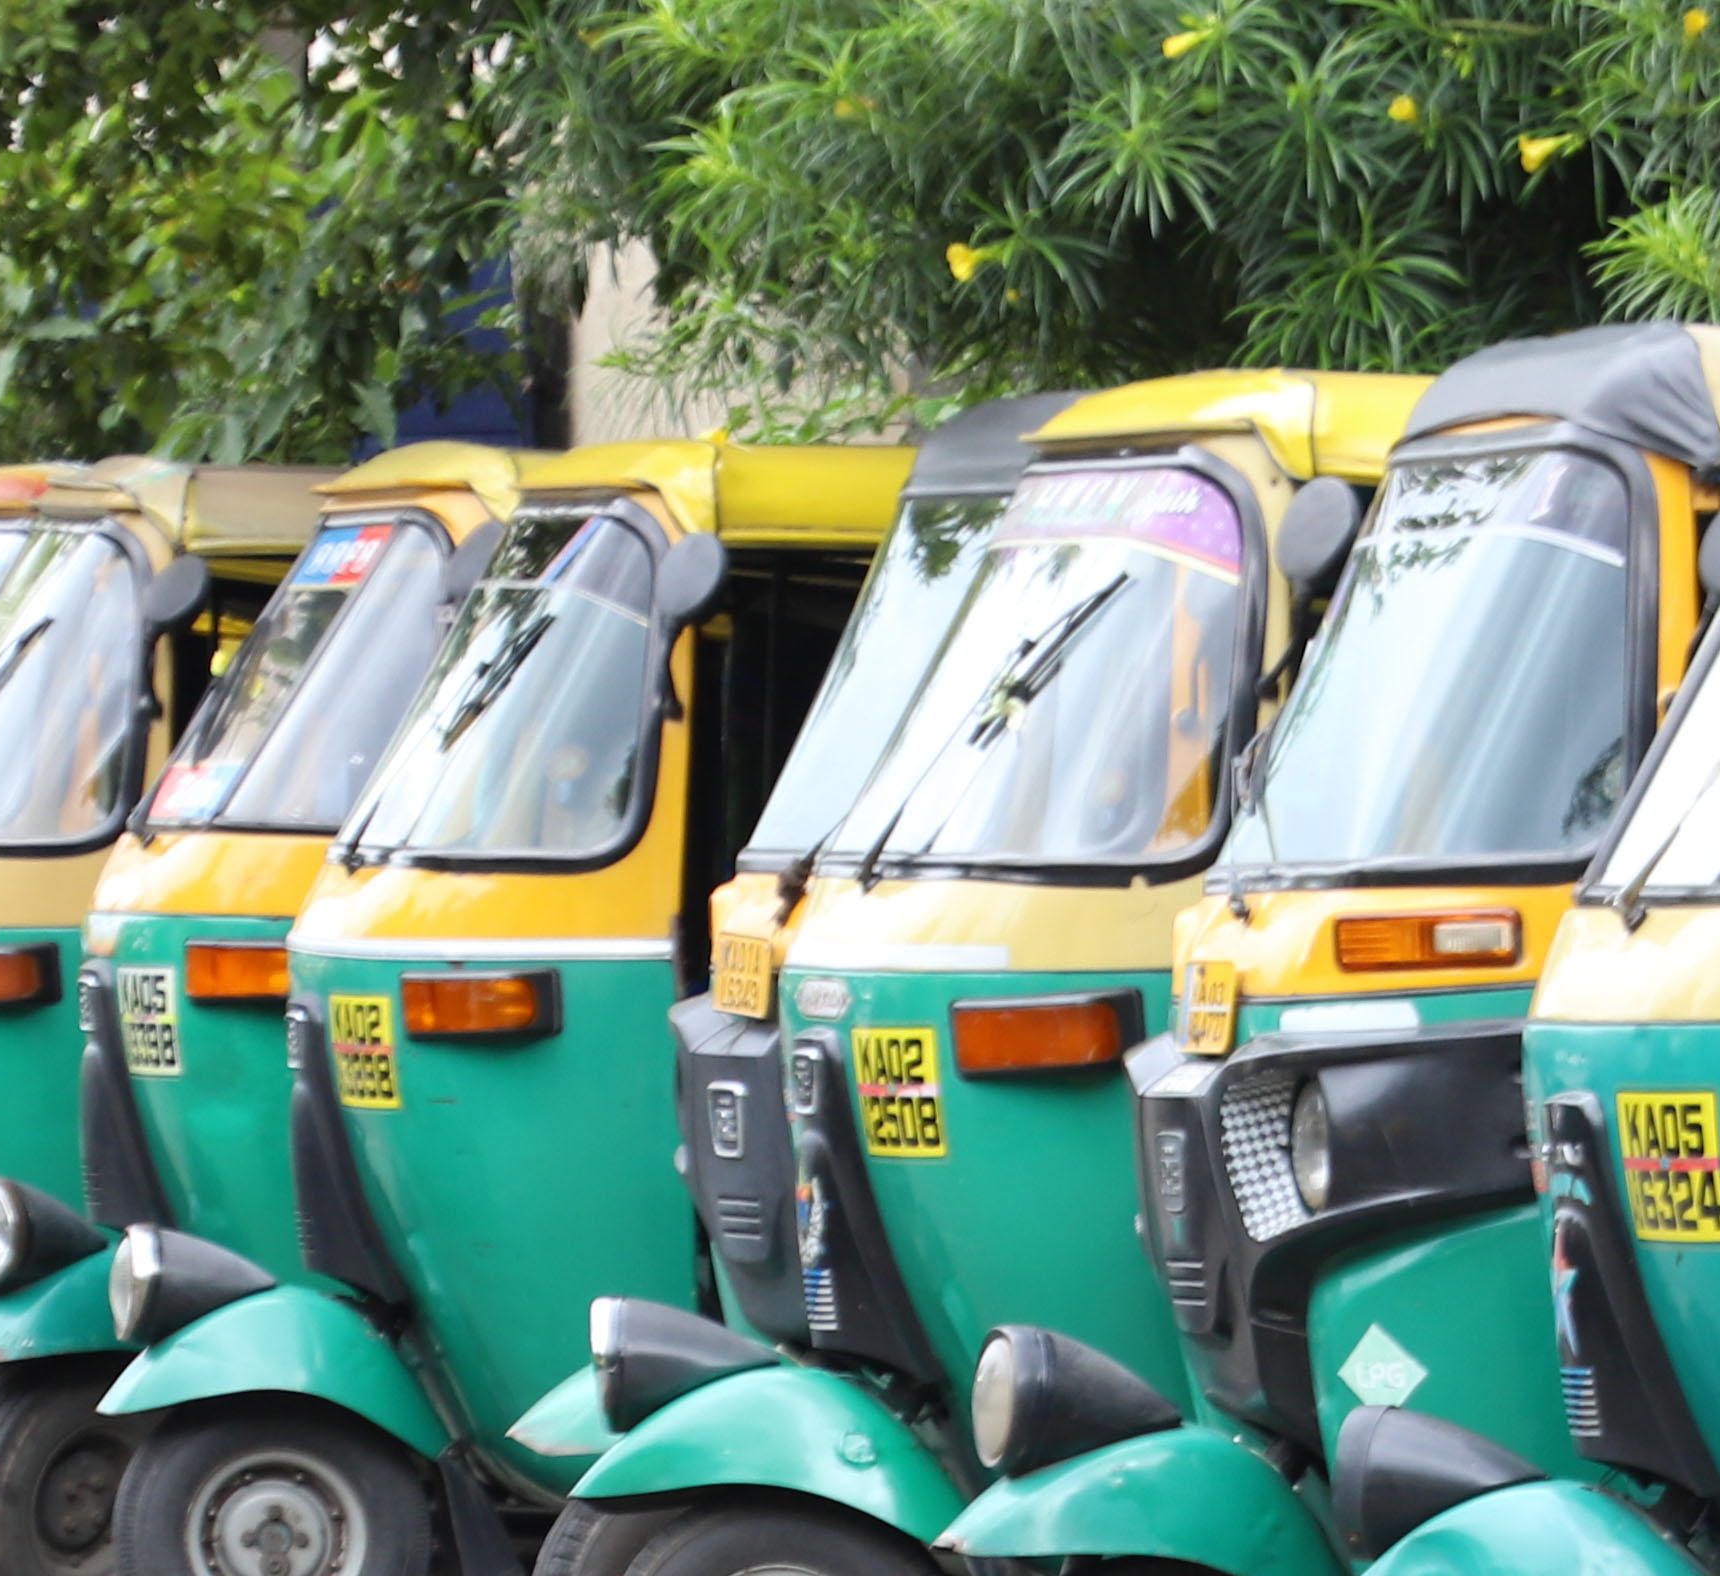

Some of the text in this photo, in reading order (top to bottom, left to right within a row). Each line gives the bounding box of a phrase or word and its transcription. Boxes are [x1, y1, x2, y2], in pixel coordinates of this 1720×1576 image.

[857, 1038, 924, 1084] KA02
[864, 1096, 941, 1147] 2508
[1624, 1103, 1705, 1158] KA05
[1354, 1362, 1407, 1390] LPG
